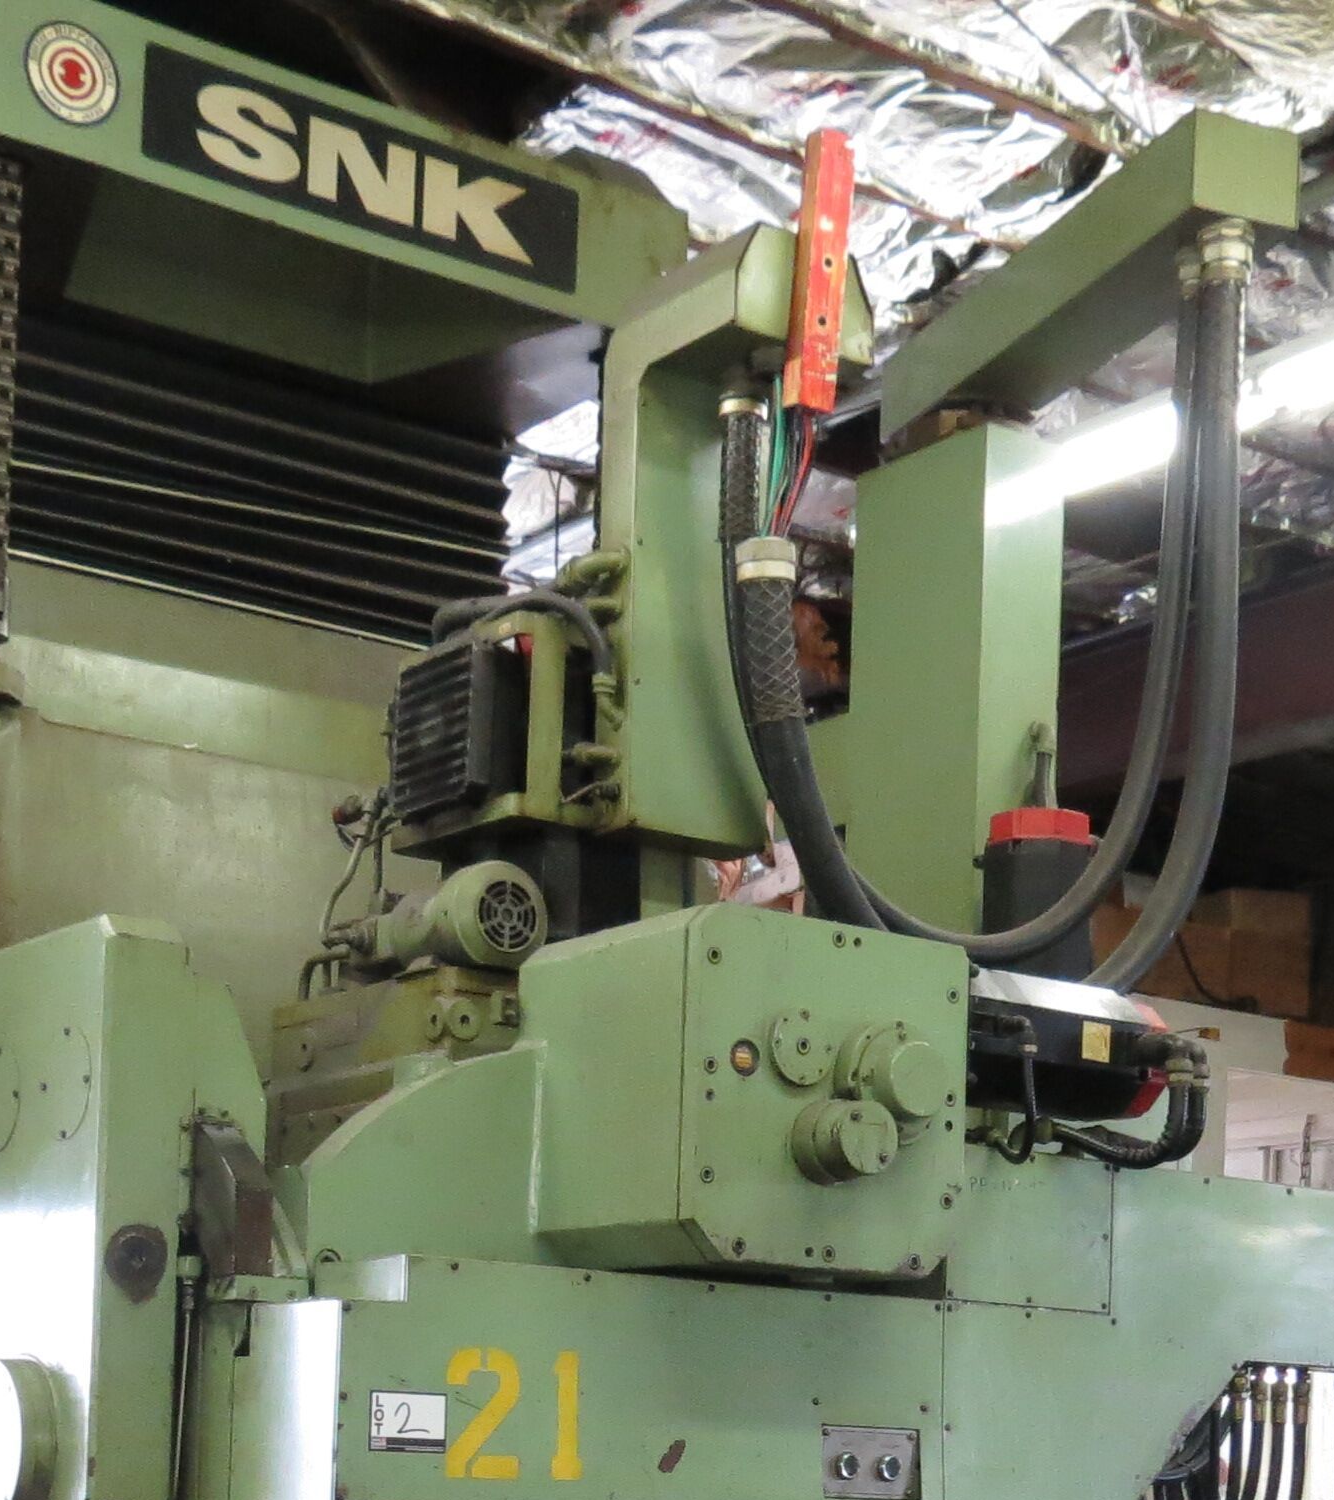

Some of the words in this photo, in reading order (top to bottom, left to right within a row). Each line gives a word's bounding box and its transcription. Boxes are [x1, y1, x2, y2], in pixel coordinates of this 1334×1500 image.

[195, 82, 535, 267] SNK
[373, 1394, 385, 1436] LOT
[393, 1401, 431, 1435] 2
[445, 1346, 582, 1481] 21
